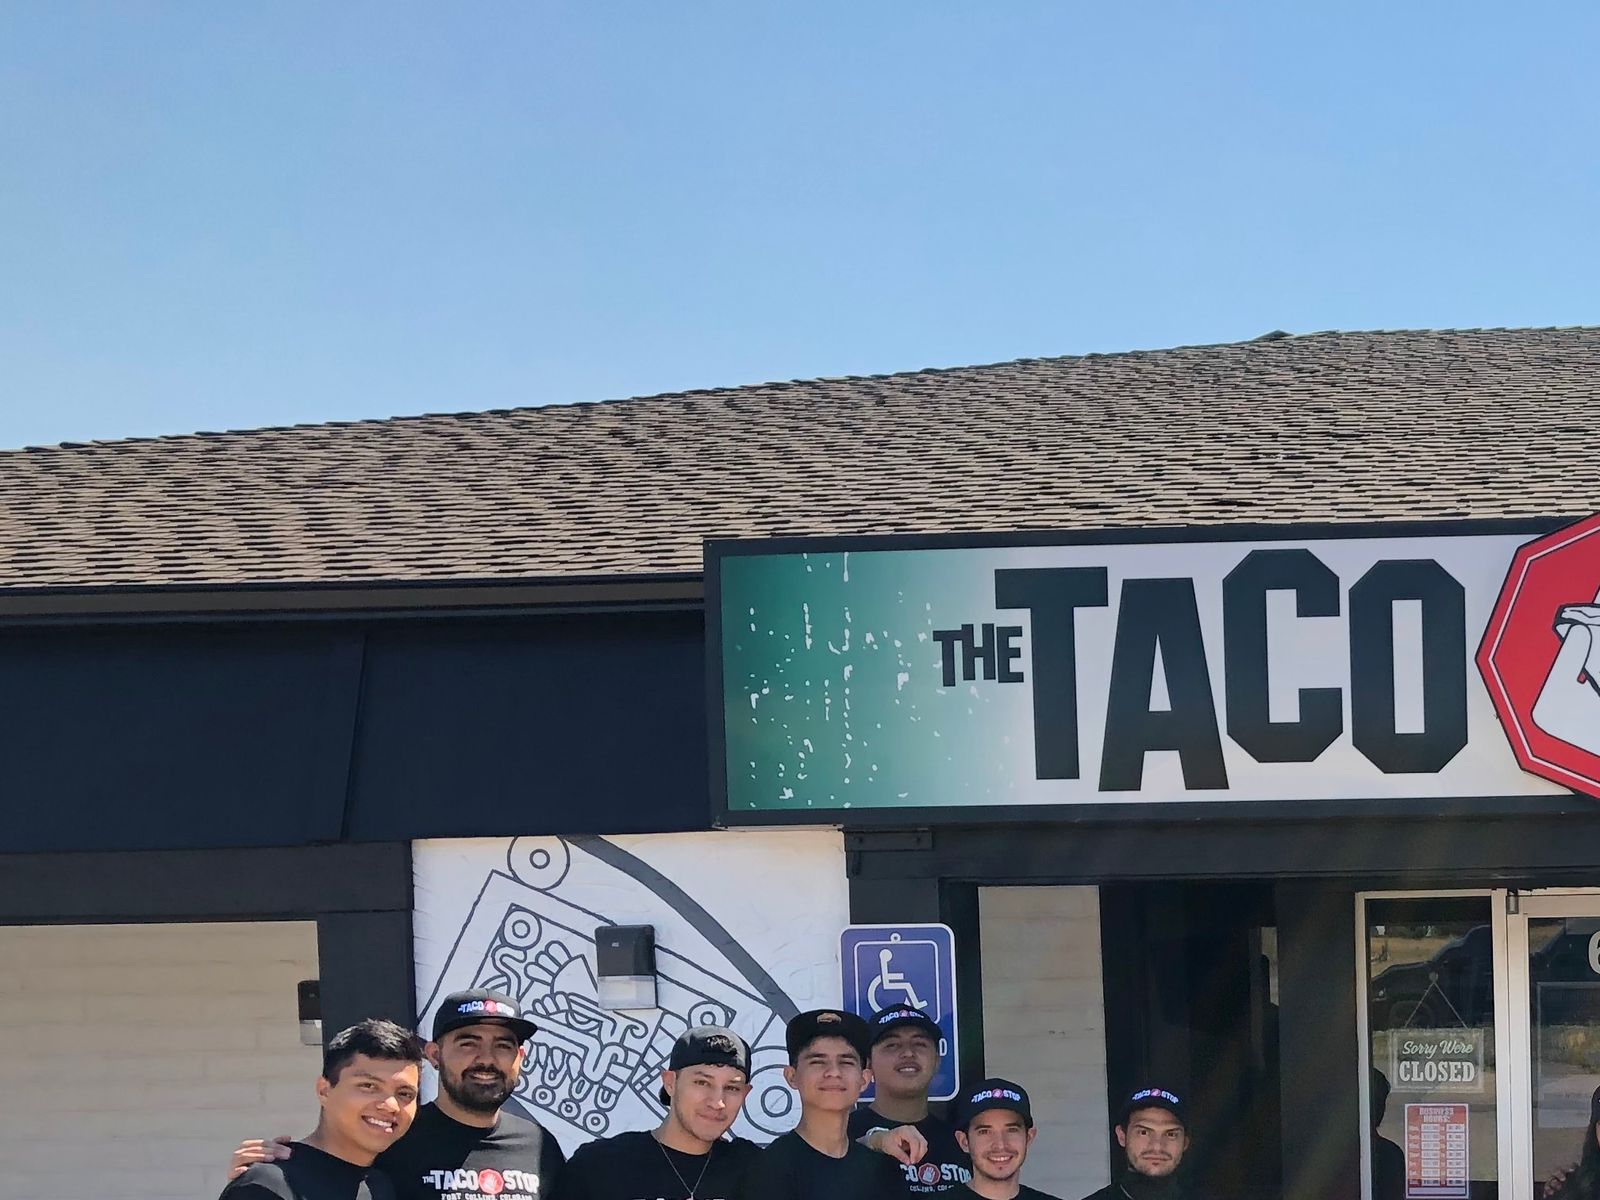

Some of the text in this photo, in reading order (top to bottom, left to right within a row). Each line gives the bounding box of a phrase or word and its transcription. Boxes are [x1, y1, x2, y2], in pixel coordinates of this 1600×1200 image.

[932, 623, 1025, 686] THE
[994, 548, 1468, 792] TACO
[460, 1001, 485, 1013] TACO
[1402, 1041, 1438, 1059] Sorry
[1399, 1061, 1475, 1081] CLOSED
[430, 1168, 480, 1191] TACO
[502, 1169, 540, 1194] STOP
